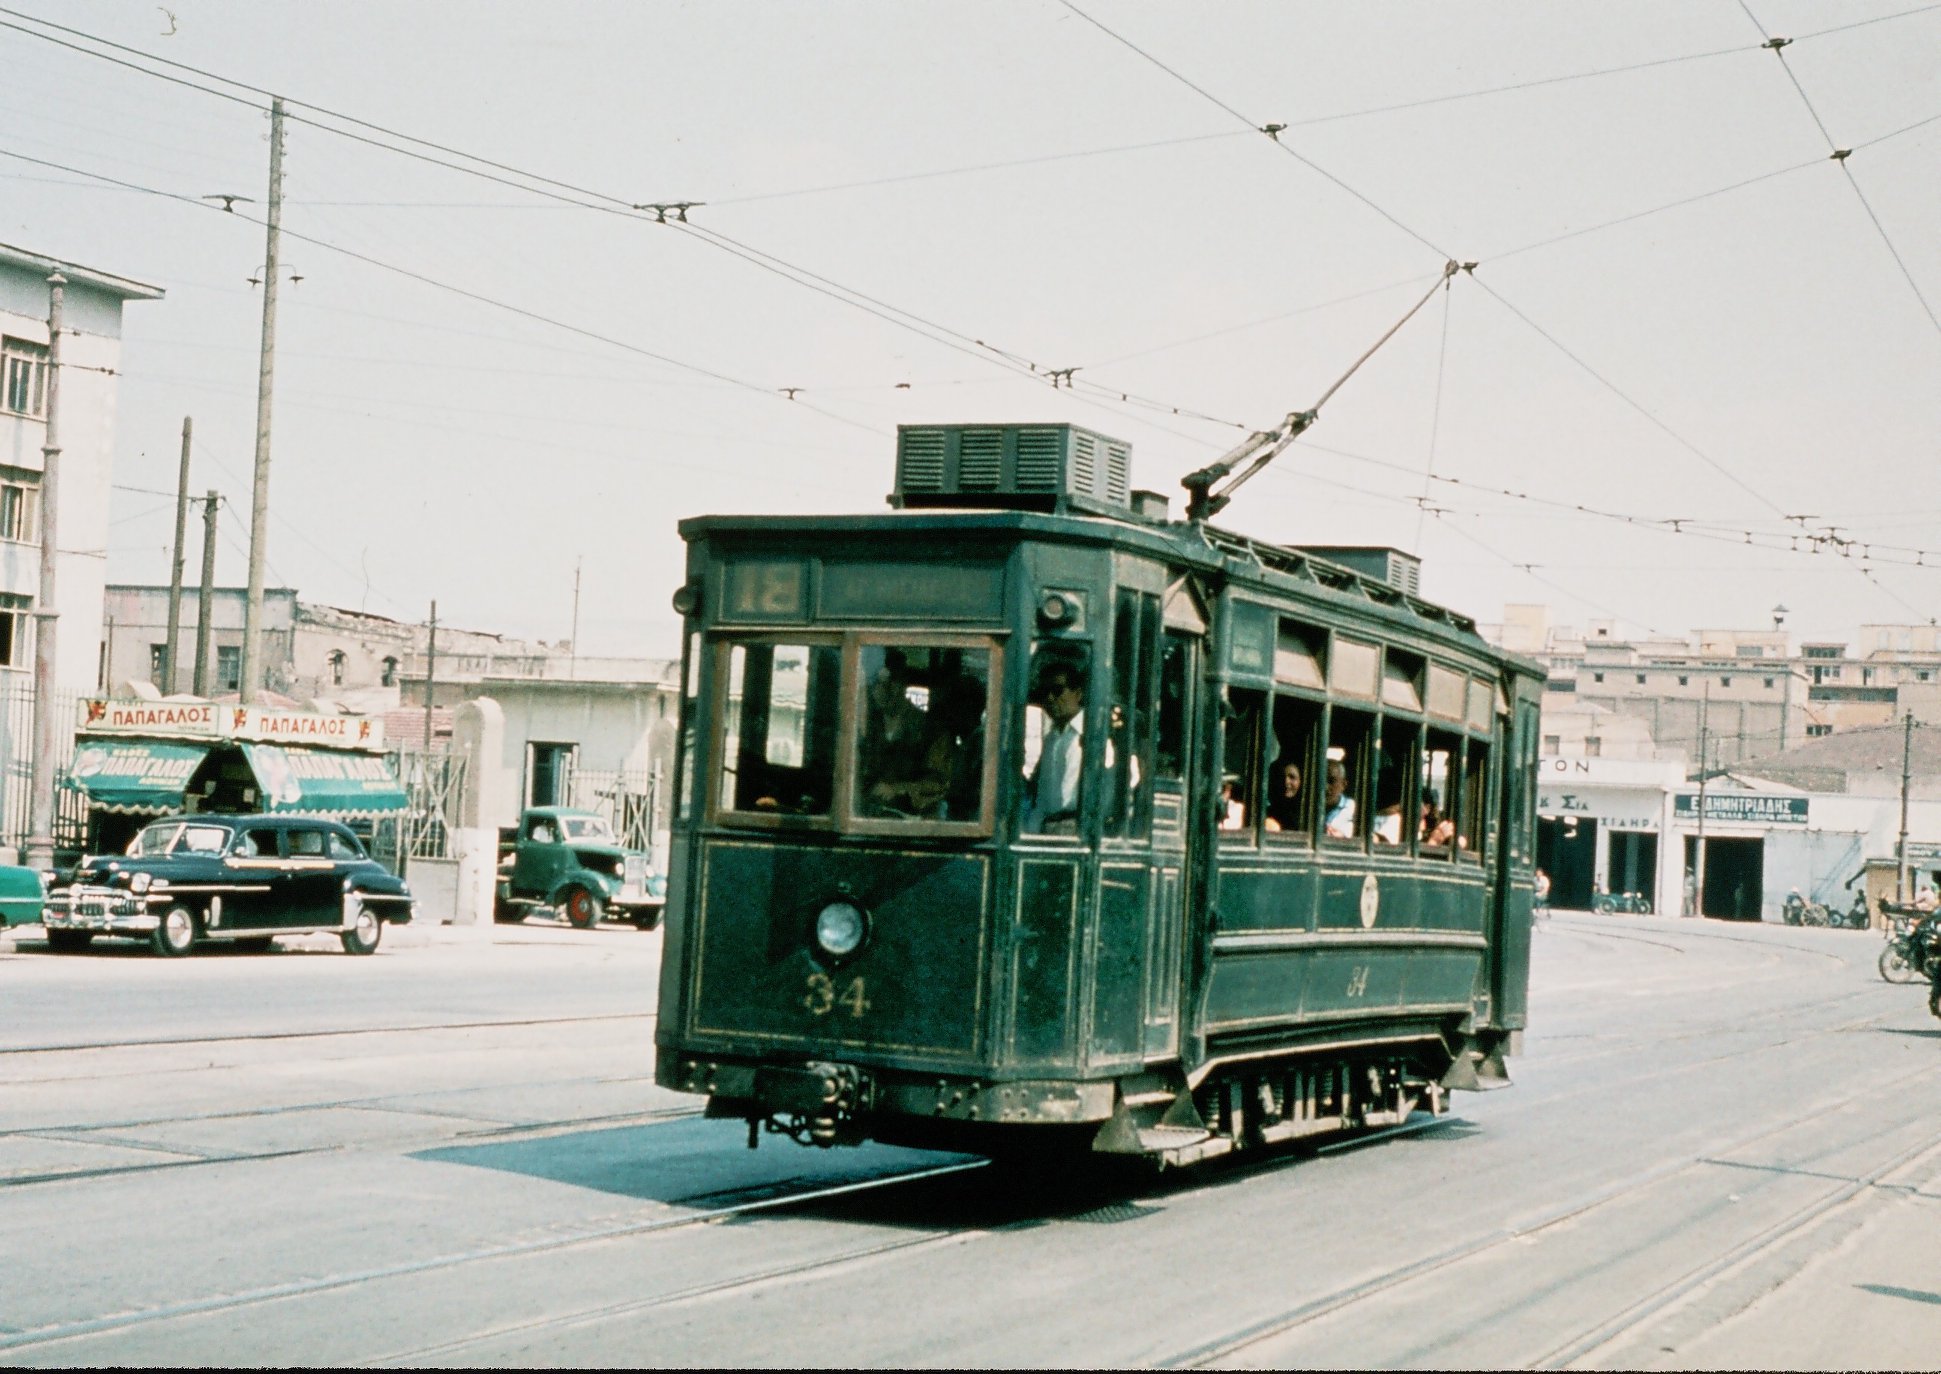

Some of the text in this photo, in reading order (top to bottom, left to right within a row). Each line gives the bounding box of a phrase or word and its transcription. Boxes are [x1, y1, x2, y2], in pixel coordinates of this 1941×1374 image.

[113, 707, 211, 725] ΠΑΠΑΓΑΛΟΣ
[260, 717, 347, 735] ΠΑΠΑΓΑΛΟΣ
[1705, 796, 1793, 813] ΔΗΜΗΤΡΙΑΔΗΣ
[1347, 965, 1369, 997] 34
[803, 973, 871, 1017] 34
